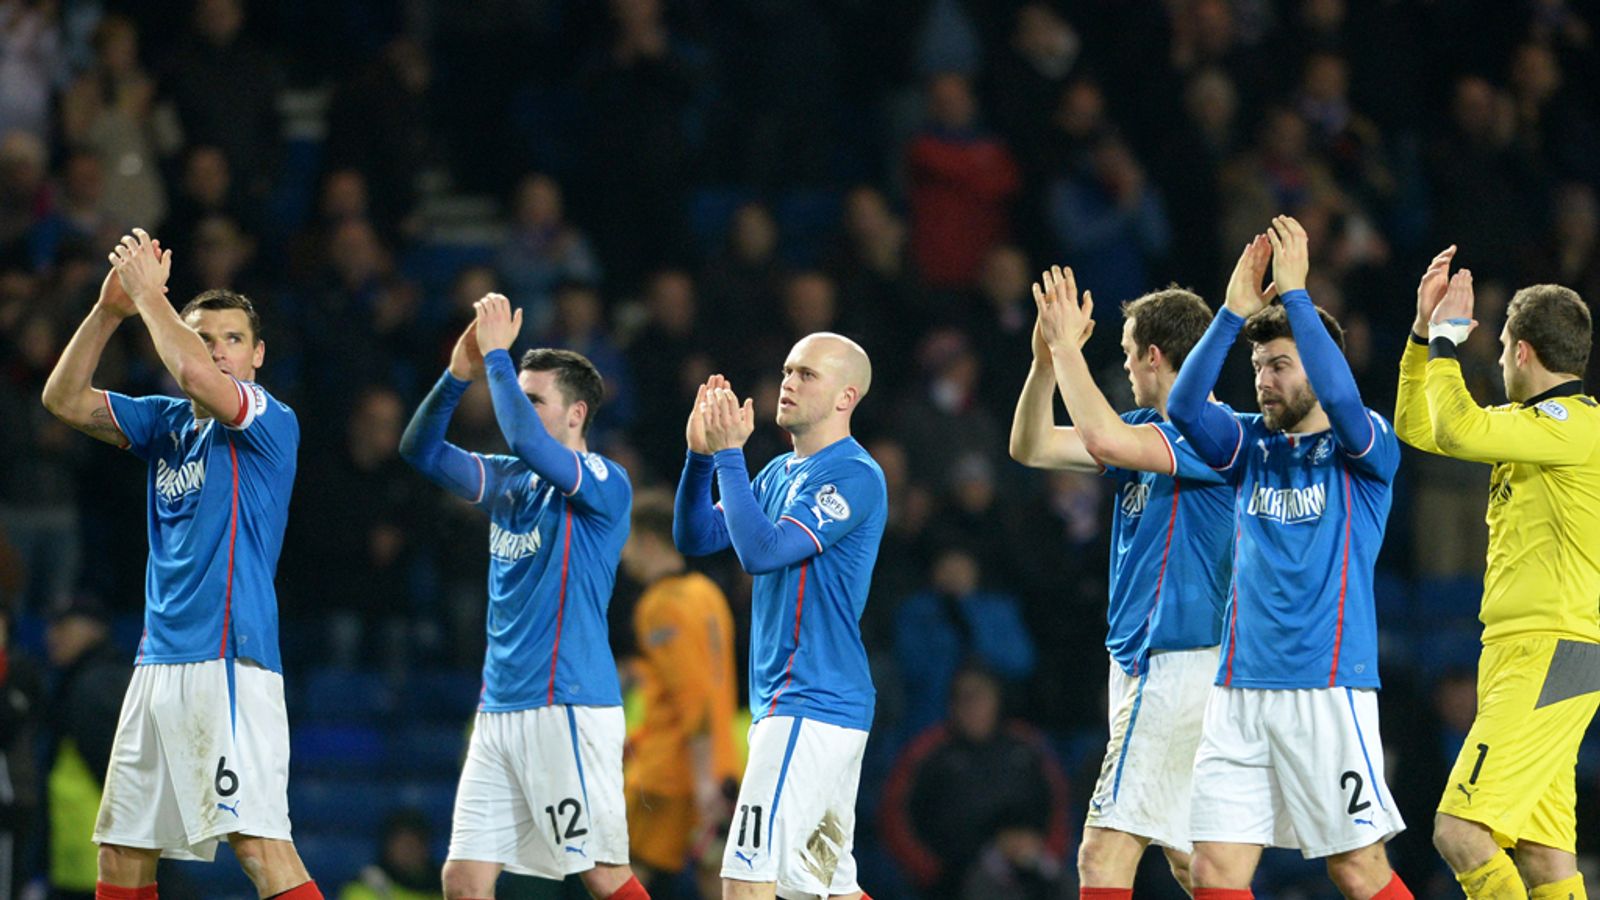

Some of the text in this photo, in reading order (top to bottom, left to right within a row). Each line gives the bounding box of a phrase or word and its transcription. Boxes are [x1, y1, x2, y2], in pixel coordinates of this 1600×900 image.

[825, 495, 846, 516] SPFL
[215, 756, 239, 797] 6
[1469, 743, 1489, 785] 1
[1340, 770, 1372, 815] 2
[545, 798, 588, 845] 12
[738, 804, 762, 848] 11
